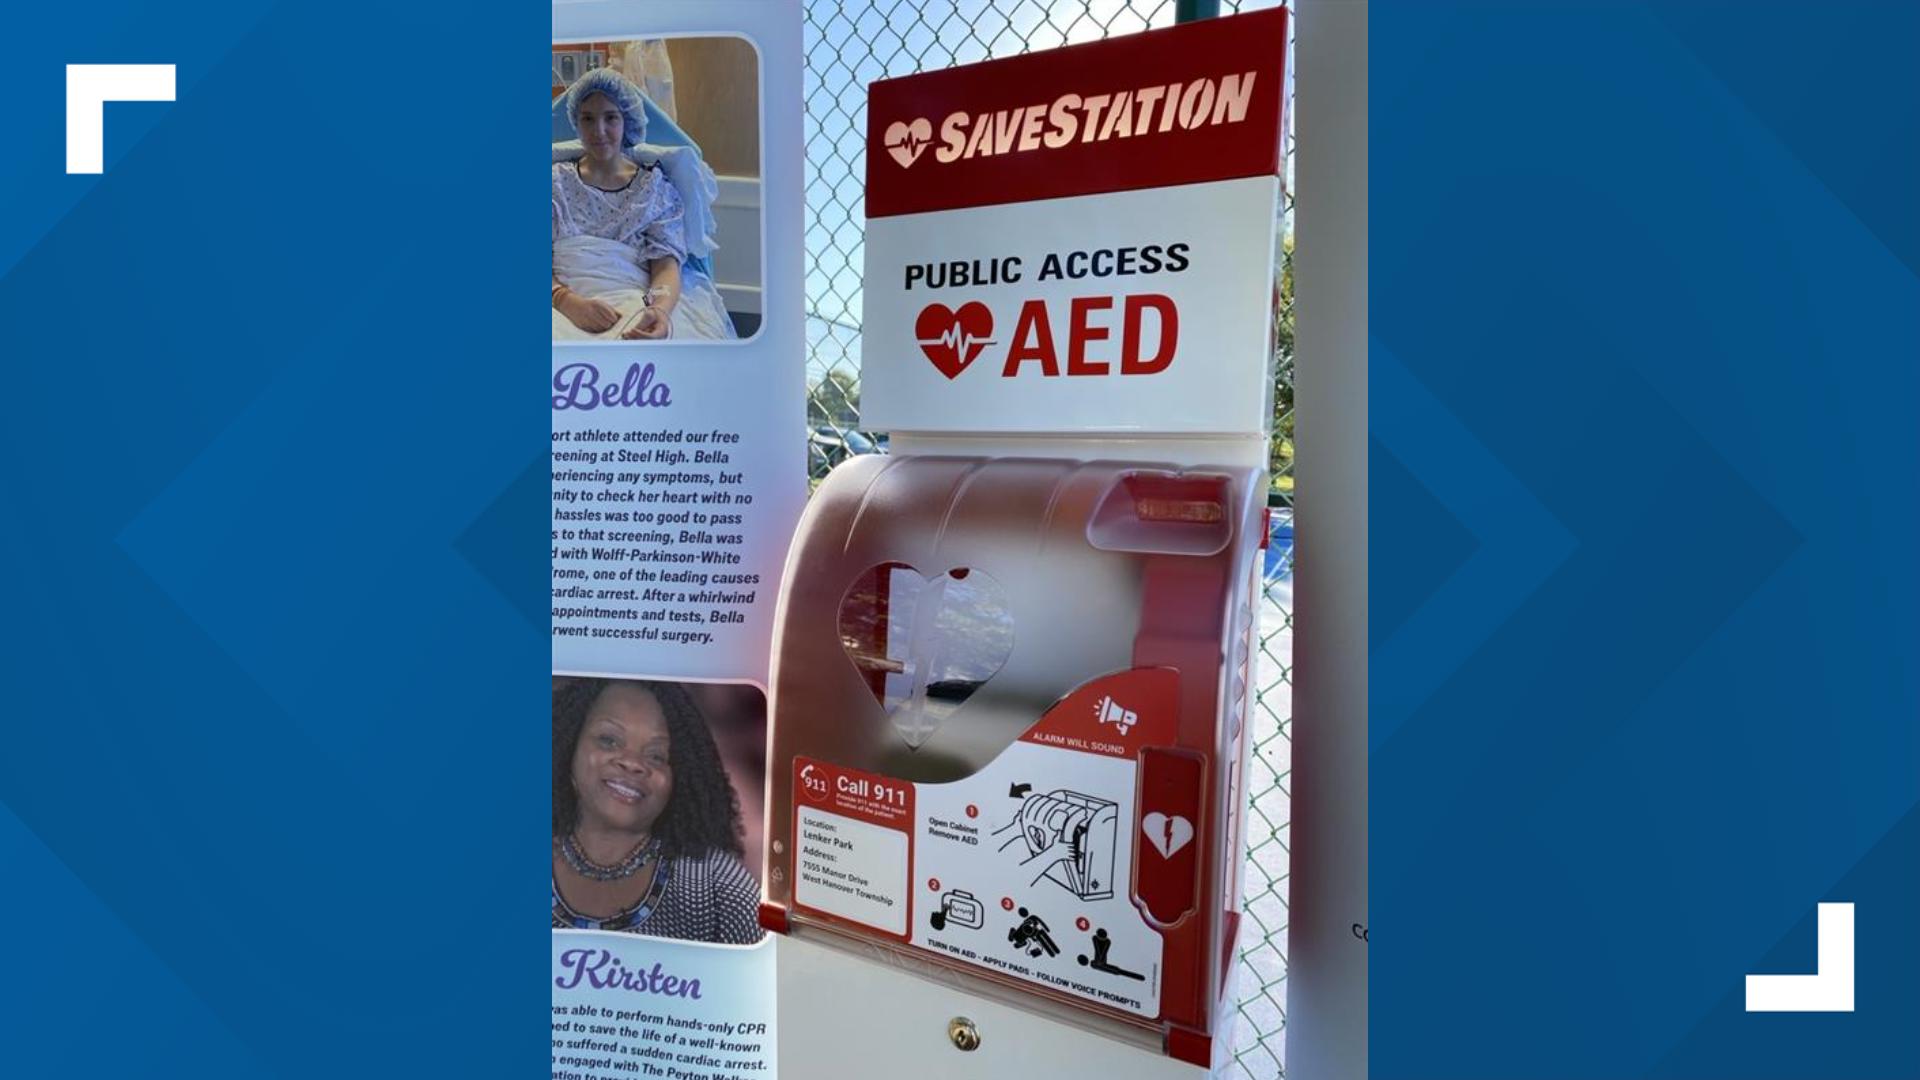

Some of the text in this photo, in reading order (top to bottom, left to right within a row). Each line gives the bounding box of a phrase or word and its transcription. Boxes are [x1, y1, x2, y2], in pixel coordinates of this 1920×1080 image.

[905, 243, 1189, 290] PUBLIC ACCESS
[1002, 294, 1179, 377] AED
[552, 362, 672, 411] Bella
[574, 429, 620, 442] athlete
[623, 431, 683, 442] attended
[686, 433, 708, 442] our
[711, 430, 739, 443] free
[601, 451, 615, 462] at
[618, 449, 652, 462] Steel
[655, 450, 689, 465] High.
[695, 450, 729, 463] Bella
[618, 472, 640, 484] any
[643, 472, 714, 486] symptoms,
[719, 471, 743, 484] but
[581, 490, 593, 500] to
[597, 489, 635, 502] check
[638, 490, 660, 502] her
[662, 491, 698, 503] heart
[701, 491, 731, 504] with
[735, 495, 753, 504] no
[555, 508, 742, 526] hassles was too good to pass
[562, 528, 574, 539] to
[579, 528, 604, 540] that
[608, 530, 674, 545] screening,
[679, 531, 712, 544] Bella
[716, 534, 743, 544] was
[561, 548, 588, 559] with
[593, 548, 741, 564] Wolff-Parkinson-White
[552, 567, 759, 585] rome, one of the leading causes
[597, 590, 638, 600] arrest.
[643, 588, 675, 602] After
[677, 593, 685, 602] a
[689, 591, 756, 603] whirlwind
[552, 606, 744, 624] appointments and tests, Bella
[592, 626, 658, 639] successful
[662, 631, 713, 644] surgery.
[1033, 732, 1124, 754] ALARM WILL SOUND
[805, 777, 826, 792] 911
[837, 775, 904, 806] Call 911
[804, 816, 837, 831] Location:
[929, 817, 978, 834] Open Cabinet
[804, 830, 853, 850] Lenker Park
[929, 827, 978, 845] Remove AED
[803, 846, 837, 862] Address:
[803, 860, 868, 886] 7555 Manor Drive
[802, 873, 893, 906] West Hanover Township
[555, 948, 702, 999] Kirsten
[928, 939, 947, 950] TURN
[949, 945, 960, 954] ON
[961, 949, 976, 959] AED
[983, 956, 1007, 968] APPLY
[1009, 963, 1029, 975] PADS
[1037, 972, 1069, 987] FOLLOW
[1071, 982, 1097, 996] VOICE
[1098, 990, 1141, 1009] PROMPTS
[571, 1005, 597, 1016] able
[601, 1008, 613, 1018] to
[616, 1010, 663, 1024] perform
[667, 1015, 735, 1035] hands-only
[737, 1023, 766, 1034] CPR
[574, 1022, 585, 1033] to
[590, 1025, 616, 1034] save
[620, 1027, 639, 1038] the
[642, 1029, 661, 1041] life
[664, 1033, 677, 1043] of
[679, 1037, 685, 1045] a
[690, 1038, 760, 1052] well-known
[567, 1039, 618, 1052] suffered
[631, 1046, 673, 1060] sudden
[677, 1054, 721, 1067] cardiac
[724, 1060, 767, 1070] arrest.
[560, 1056, 611, 1068] engaged
[614, 1060, 639, 1072] with
[642, 1063, 663, 1076] The
[667, 1067, 708, 1080] Peyton
